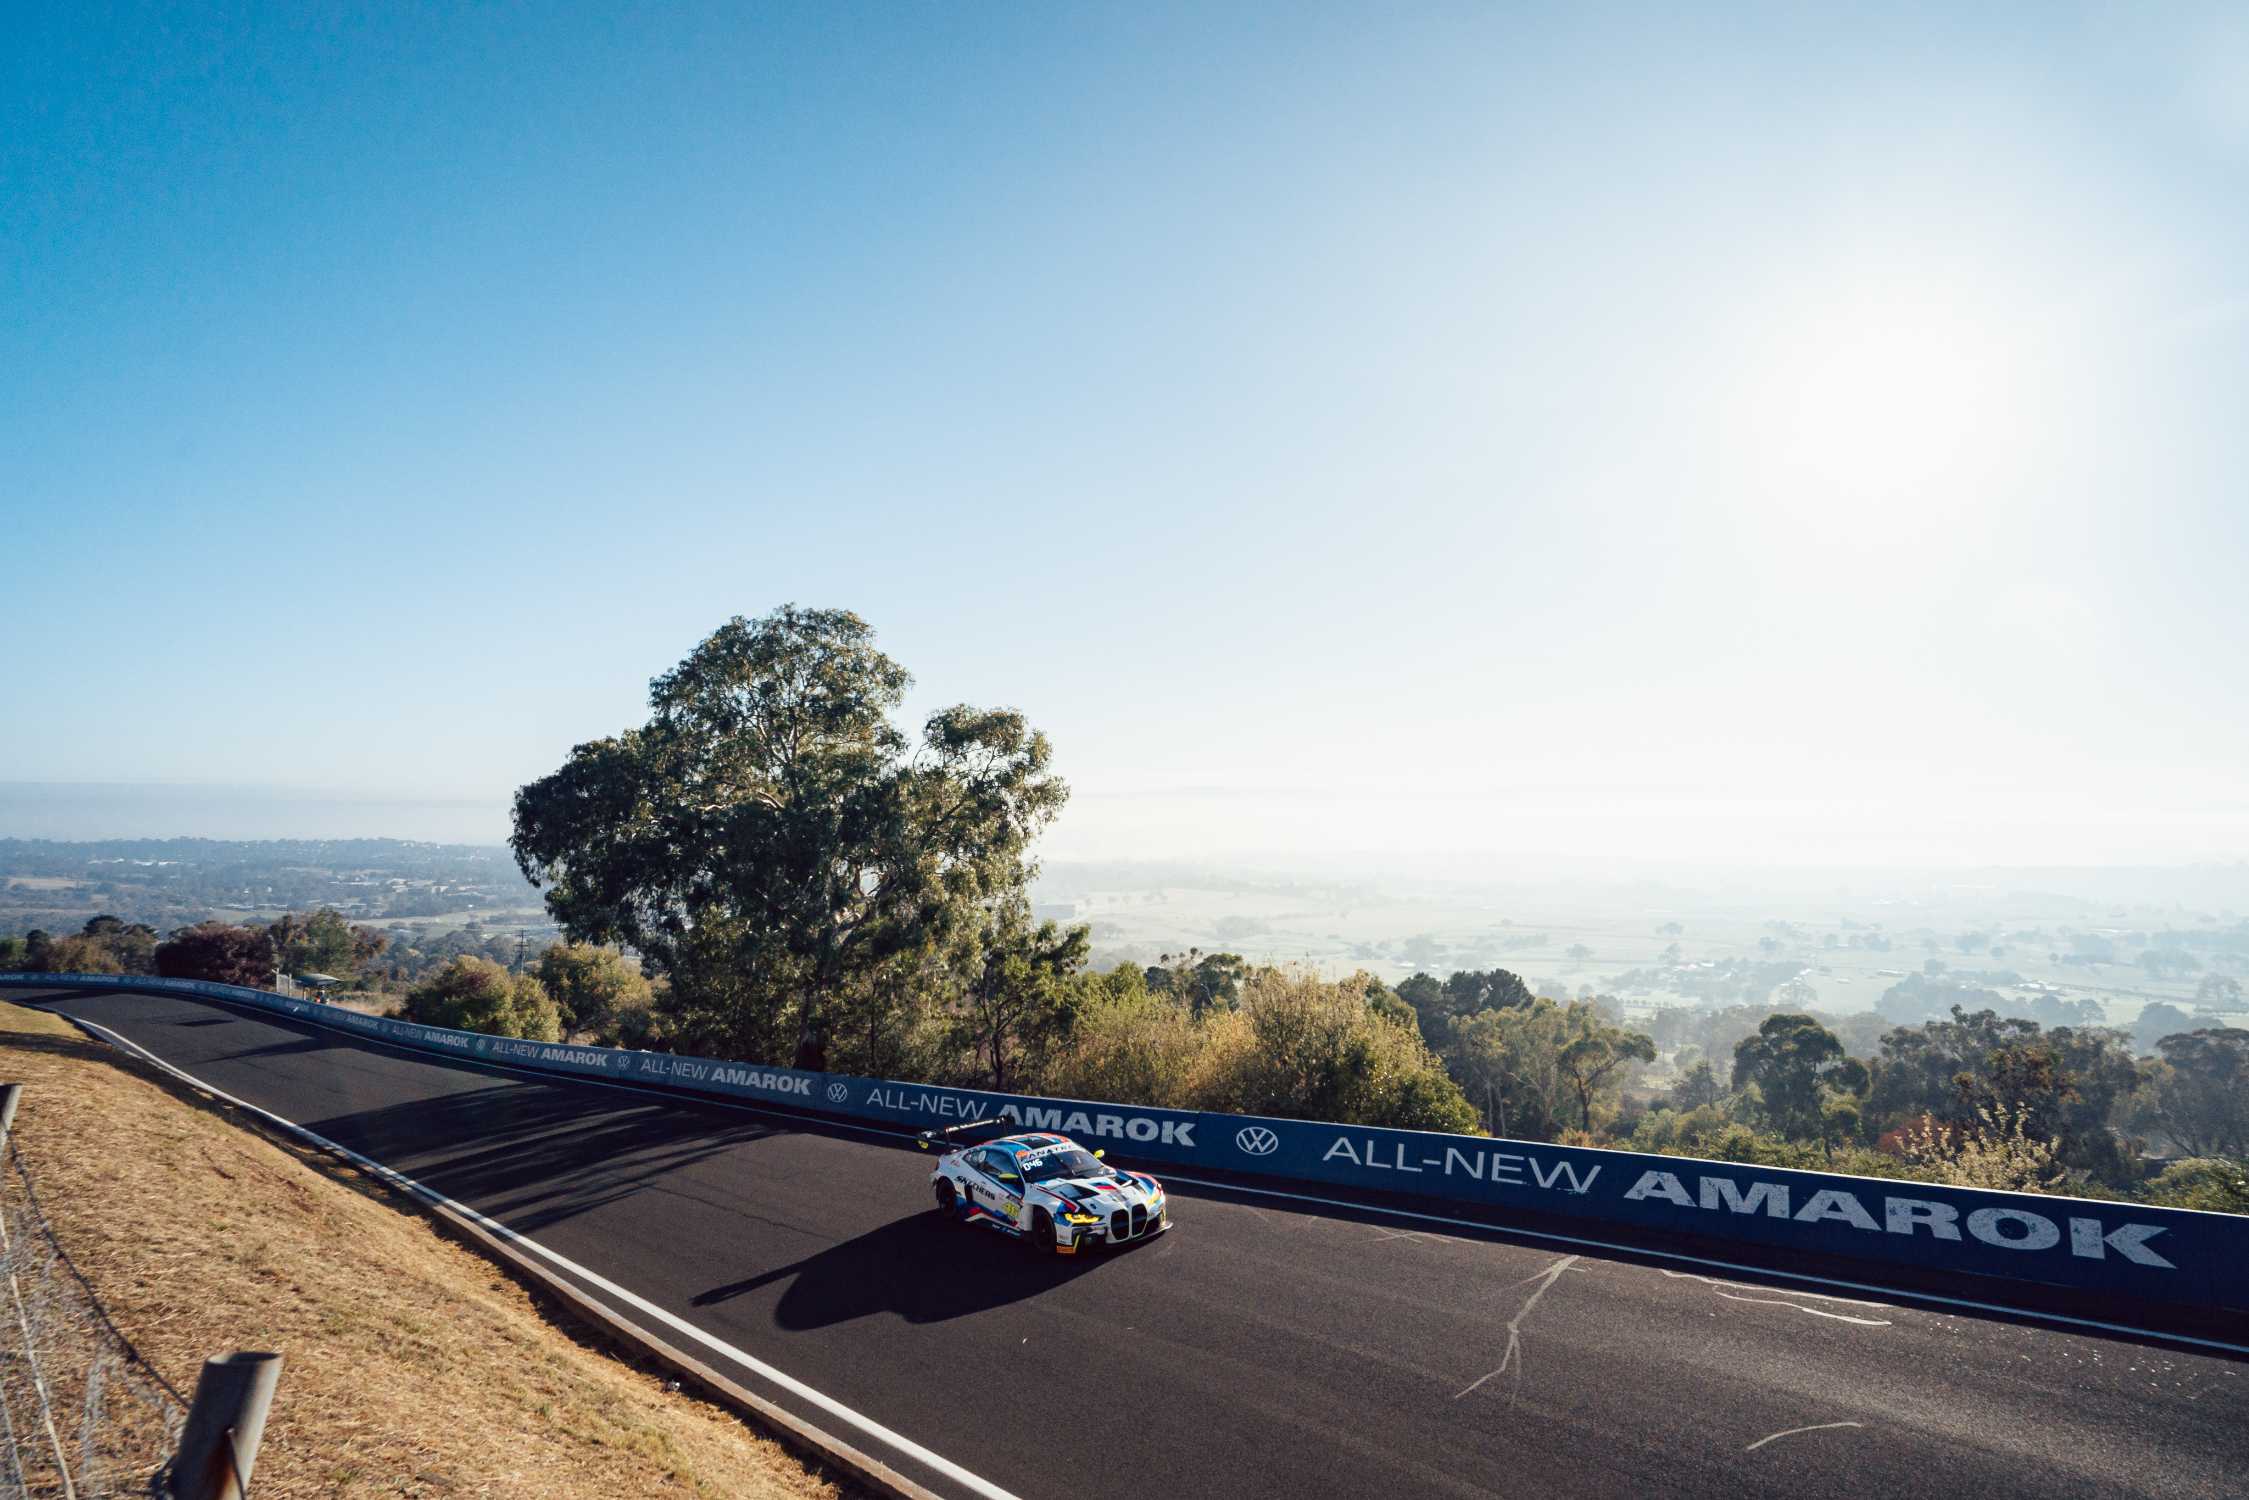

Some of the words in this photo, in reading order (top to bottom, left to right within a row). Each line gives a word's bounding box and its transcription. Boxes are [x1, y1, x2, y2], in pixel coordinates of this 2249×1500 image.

[424, 1031, 468, 1048] AMAROK
[492, 1041, 539, 1058] ALL-NEW
[540, 1047, 607, 1067] AMAROK
[640, 1058, 709, 1081] ALL-NEW
[710, 1067, 813, 1096] AMAROK
[866, 1088, 988, 1121] ALL-NEW
[998, 1103, 1197, 1148] AMAROK
[1322, 1136, 1602, 1194] ALL-NEW
[1623, 1169, 2178, 1270] AMAROK
